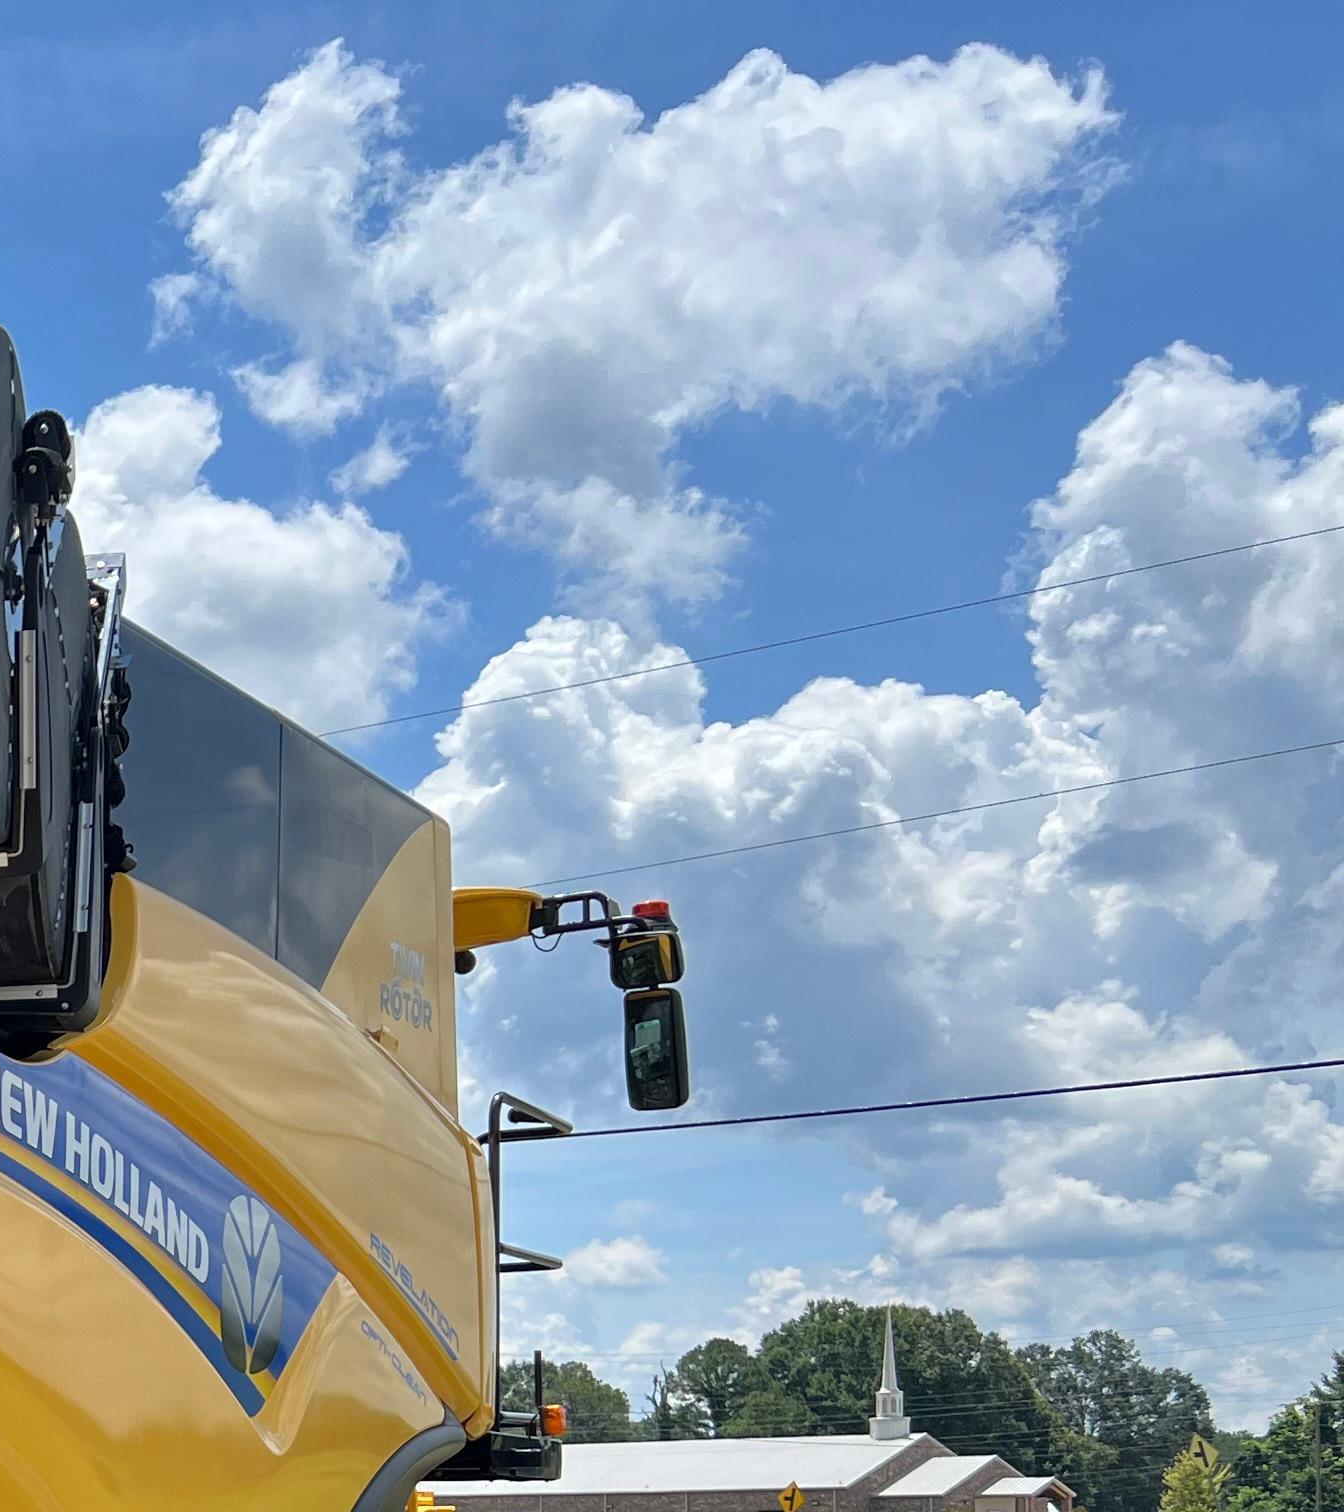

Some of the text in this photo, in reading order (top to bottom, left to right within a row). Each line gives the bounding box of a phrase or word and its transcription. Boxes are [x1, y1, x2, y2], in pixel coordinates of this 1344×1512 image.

[379, 976, 433, 1033] ROTOR
[390, 940, 425, 987] TWIN
[65, 1118, 211, 1286] HOLLAND
[369, 1231, 460, 1353] REVELATION
